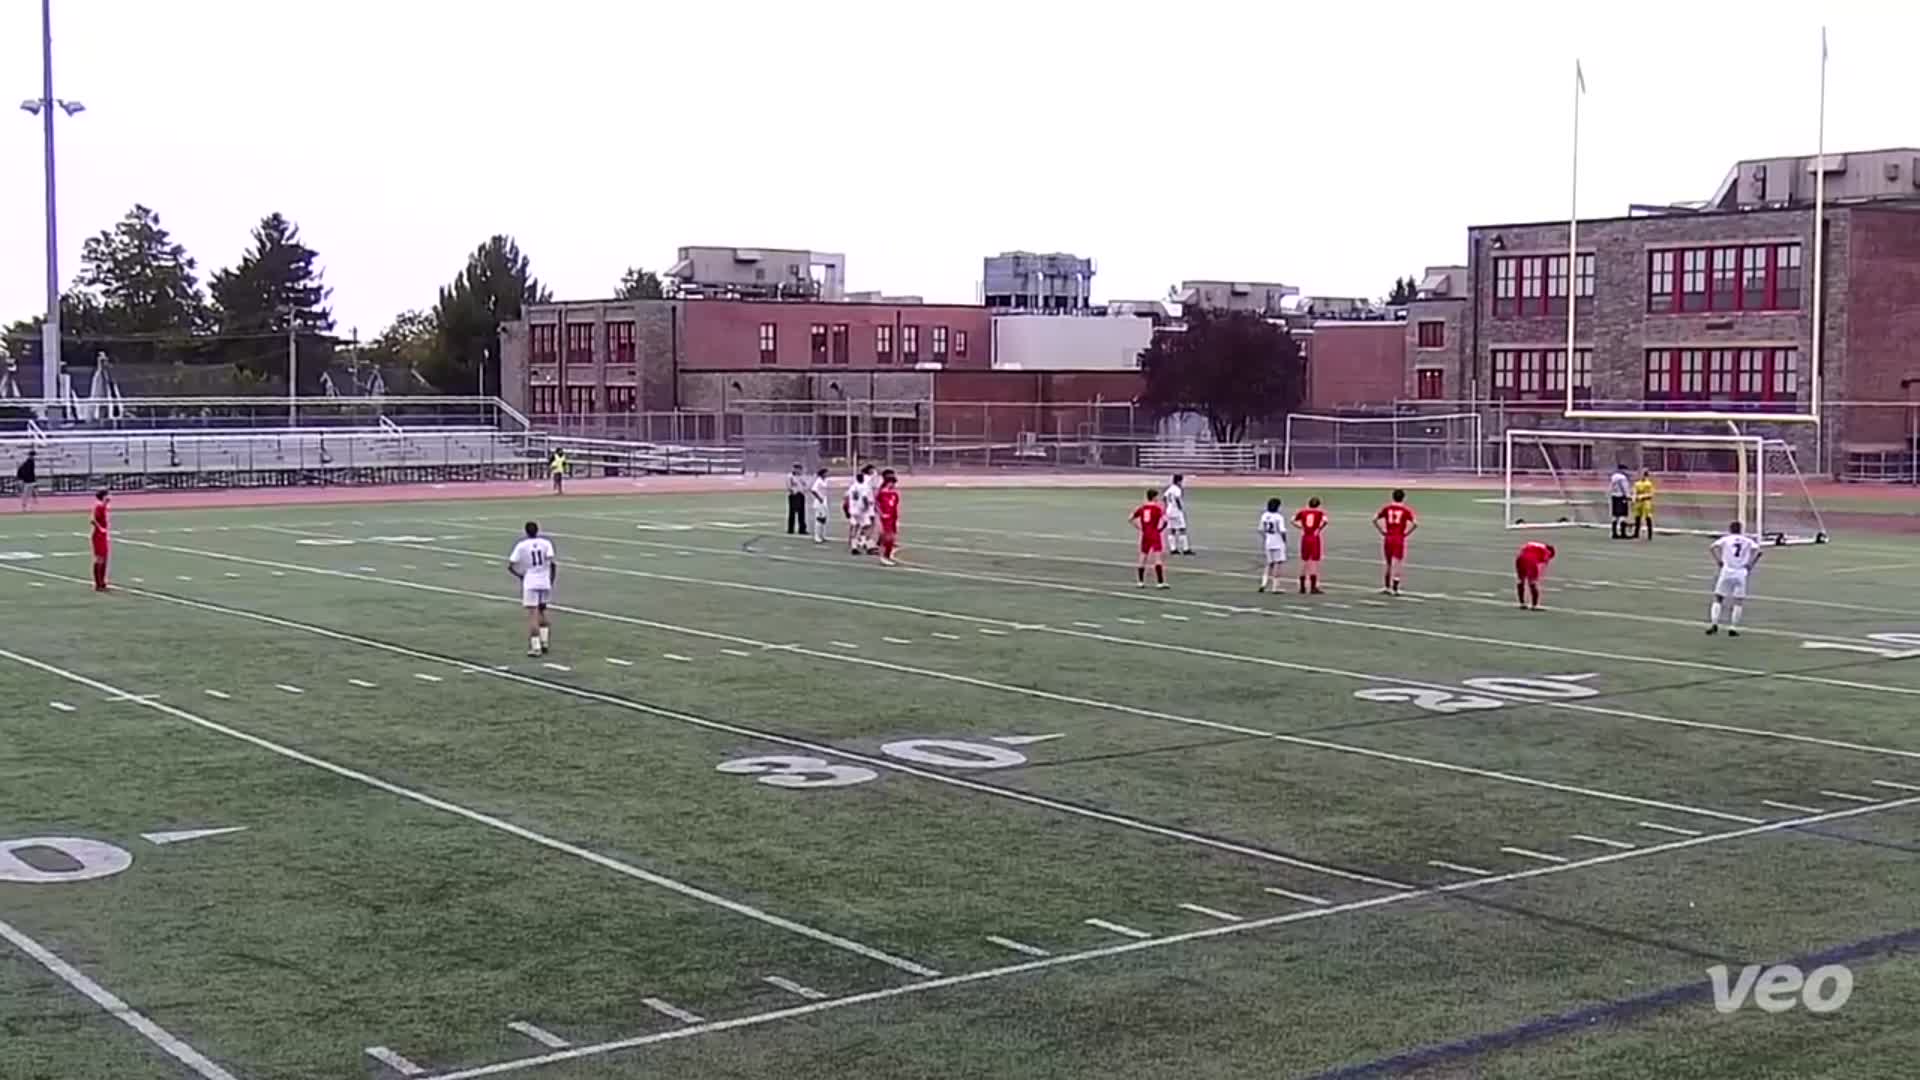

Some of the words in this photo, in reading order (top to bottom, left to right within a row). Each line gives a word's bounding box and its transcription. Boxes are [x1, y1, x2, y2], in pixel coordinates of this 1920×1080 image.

[531, 550, 543, 567] 11
[1732, 543, 1743, 557] 7
[1353, 676, 1599, 713] 20
[715, 739, 1028, 788] 30
